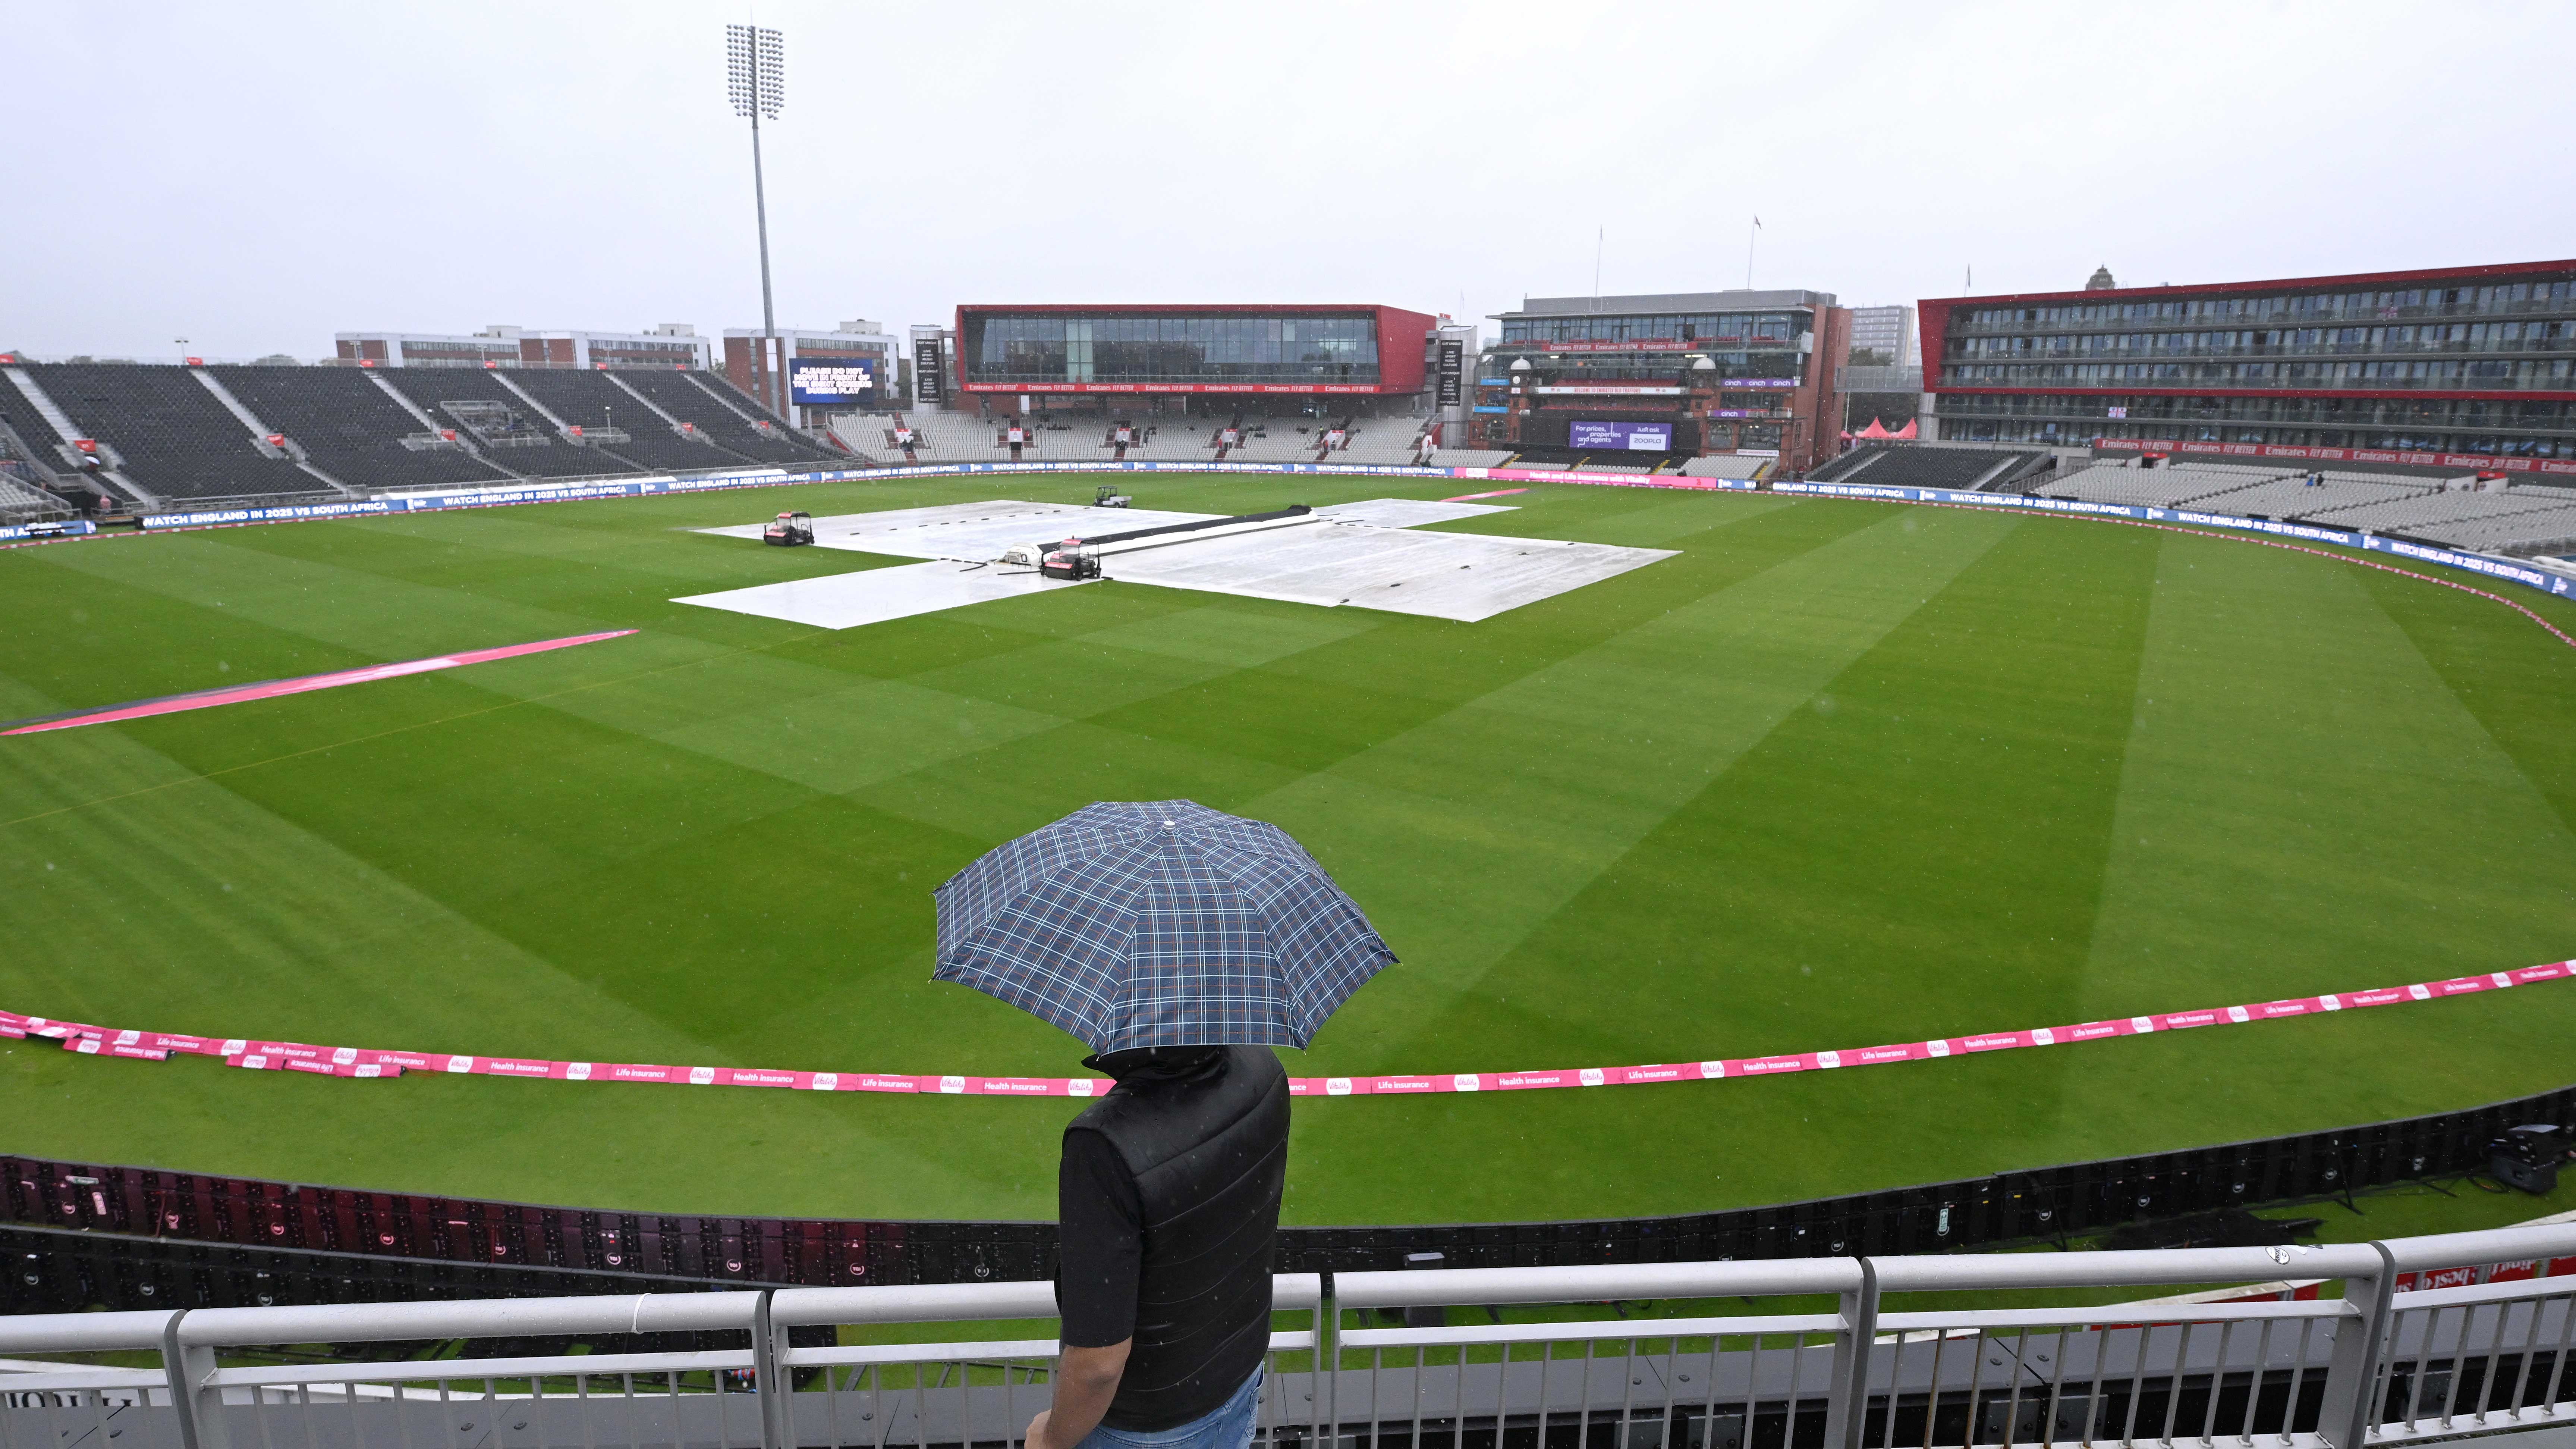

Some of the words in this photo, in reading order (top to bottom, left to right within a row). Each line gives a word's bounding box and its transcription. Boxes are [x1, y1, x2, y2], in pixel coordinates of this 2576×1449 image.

[2102, 440, 2139, 449] Emirates
[668, 482, 696, 490] WATCH
[696, 479, 730, 488] ENGLAND
[1625, 476, 1650, 484] Vitality
[443, 496, 479, 505] WATCH
[480, 492, 523, 503] ENGLAND
[535, 490, 556, 499] 2025
[570, 488, 597, 496] SOUTH
[598, 486, 626, 494] AFRICA
[1773, 483, 1808, 491] ENGLAND
[1849, 487, 1875, 495] SOUTH
[1876, 489, 1905, 498] AFRICA
[1950, 493, 1981, 503] WATCH
[1982, 496, 2023, 505] ENGLAND
[2034, 499, 2056, 508] 2025
[2057, 501, 2068, 509] VS
[2069, 502, 2098, 512] SOUTH
[2099, 505, 2131, 515] AFRICA
[142, 516, 188, 527] WATCH
[190, 511, 248, 523] ENGLAND
[250, 510, 263, 519] IN
[265, 508, 293, 518] 2025
[295, 507, 311, 516] VS
[312, 504, 348, 515] SOUTH
[350, 502, 388, 512] AFRICA
[2178, 512, 2211, 523] WATCH
[2211, 516, 2253, 528] ENGLAND
[2253, 521, 2263, 530] IN
[2263, 523, 2283, 533] 2025
[2283, 525, 2294, 534] VS
[2294, 527, 2320, 538] SOUTH
[2320, 531, 2349, 543] AFRICA
[170, 1039, 199, 1049] insurance
[1964, 1039, 1986, 1048] Health
[1987, 1037, 2017, 1045] insurance
[261, 1045, 284, 1054] Health
[284, 1048, 317, 1057] insurance
[1862, 1051, 1875, 1060] Life
[1876, 1050, 1907, 1058] insurance
[393, 1056, 425, 1066] insurance
[451, 1059, 469, 1068] Vitality
[1743, 1062, 1767, 1071] Health
[1768, 1060, 1800, 1069] insurance
[491, 1062, 515, 1070] Health
[516, 1063, 549, 1072] insurance
[568, 1066, 589, 1075] Vitality
[1702, 1064, 1723, 1074] Vitality
[616, 1068, 630, 1076] Life
[631, 1069, 666, 1078] insurance
[691, 1070, 713, 1080] Vitality
[733, 1073, 758, 1081] Health
[759, 1074, 794, 1083] insurance
[1581, 1071, 1603, 1081] Vitality
[1644, 1070, 1677, 1078] insurance
[878, 1079, 913, 1088] insurance
[941, 1079, 963, 1088] Vitality
[1011, 1083, 1047, 1091] insurance
[1069, 1082, 1092, 1092] Vitality
[1329, 1082, 1349, 1092] Vitality
[1457, 1077, 1476, 1087] Vitality
